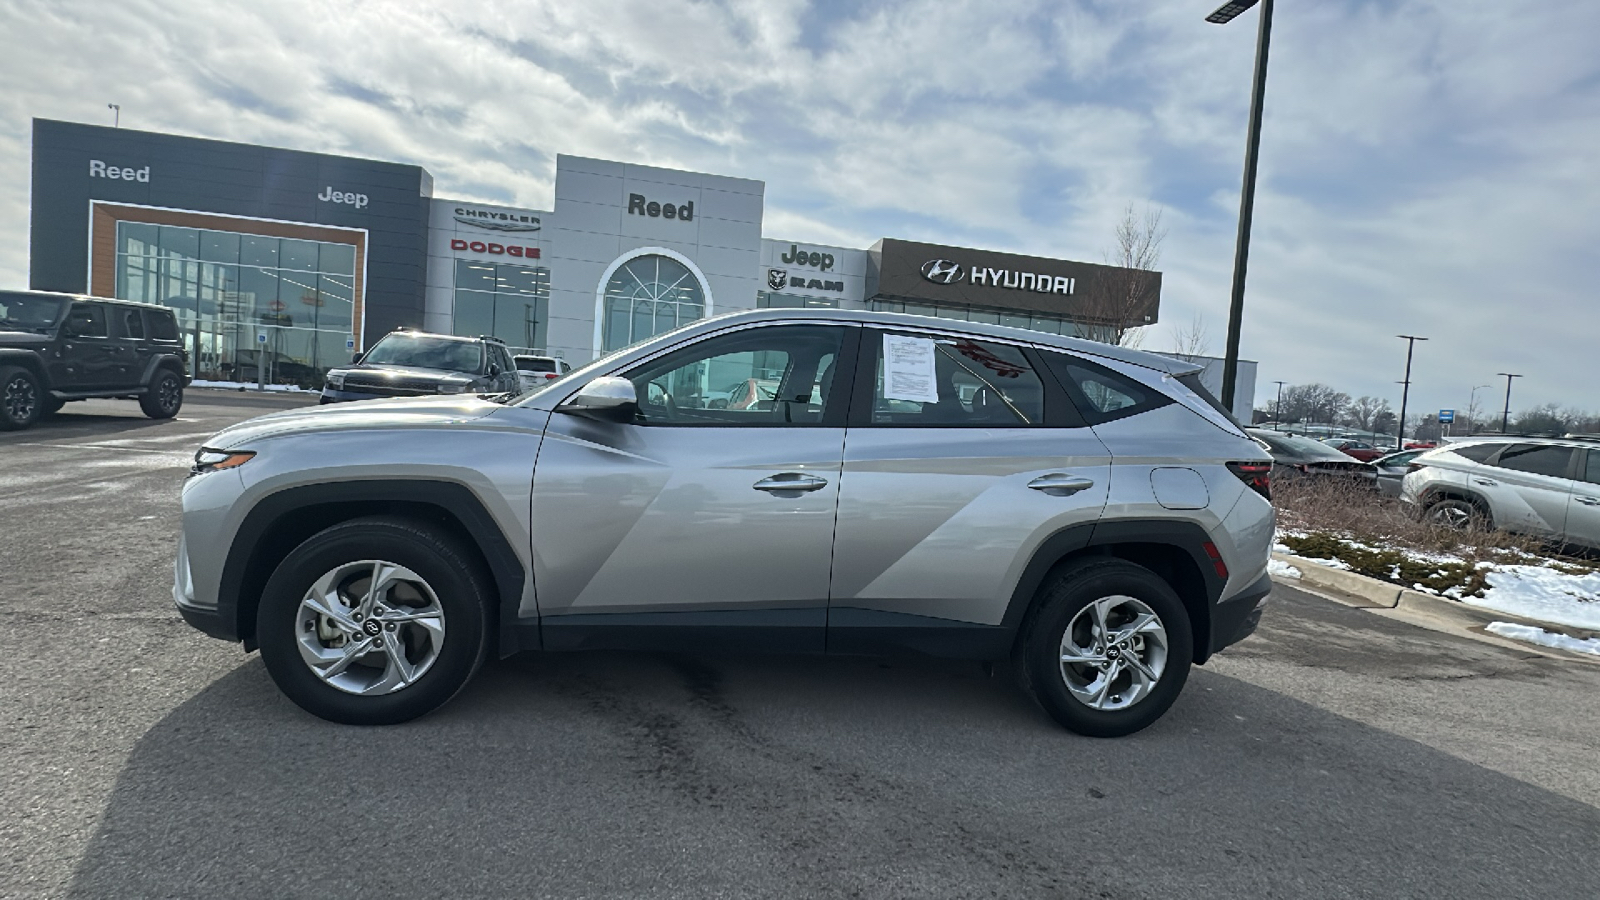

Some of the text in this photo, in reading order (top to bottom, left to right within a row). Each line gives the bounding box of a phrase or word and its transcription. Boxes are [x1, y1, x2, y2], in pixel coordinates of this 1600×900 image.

[89, 159, 150, 183] Reed
[317, 186, 369, 209] Jeep
[628, 193, 694, 221] Reed
[454, 207, 541, 224] CHRYSLER
[451, 239, 541, 259] DODGE
[781, 244, 834, 271] Jeep
[790, 276, 844, 292] RAM
[971, 266, 1076, 295] HYUNDAI
